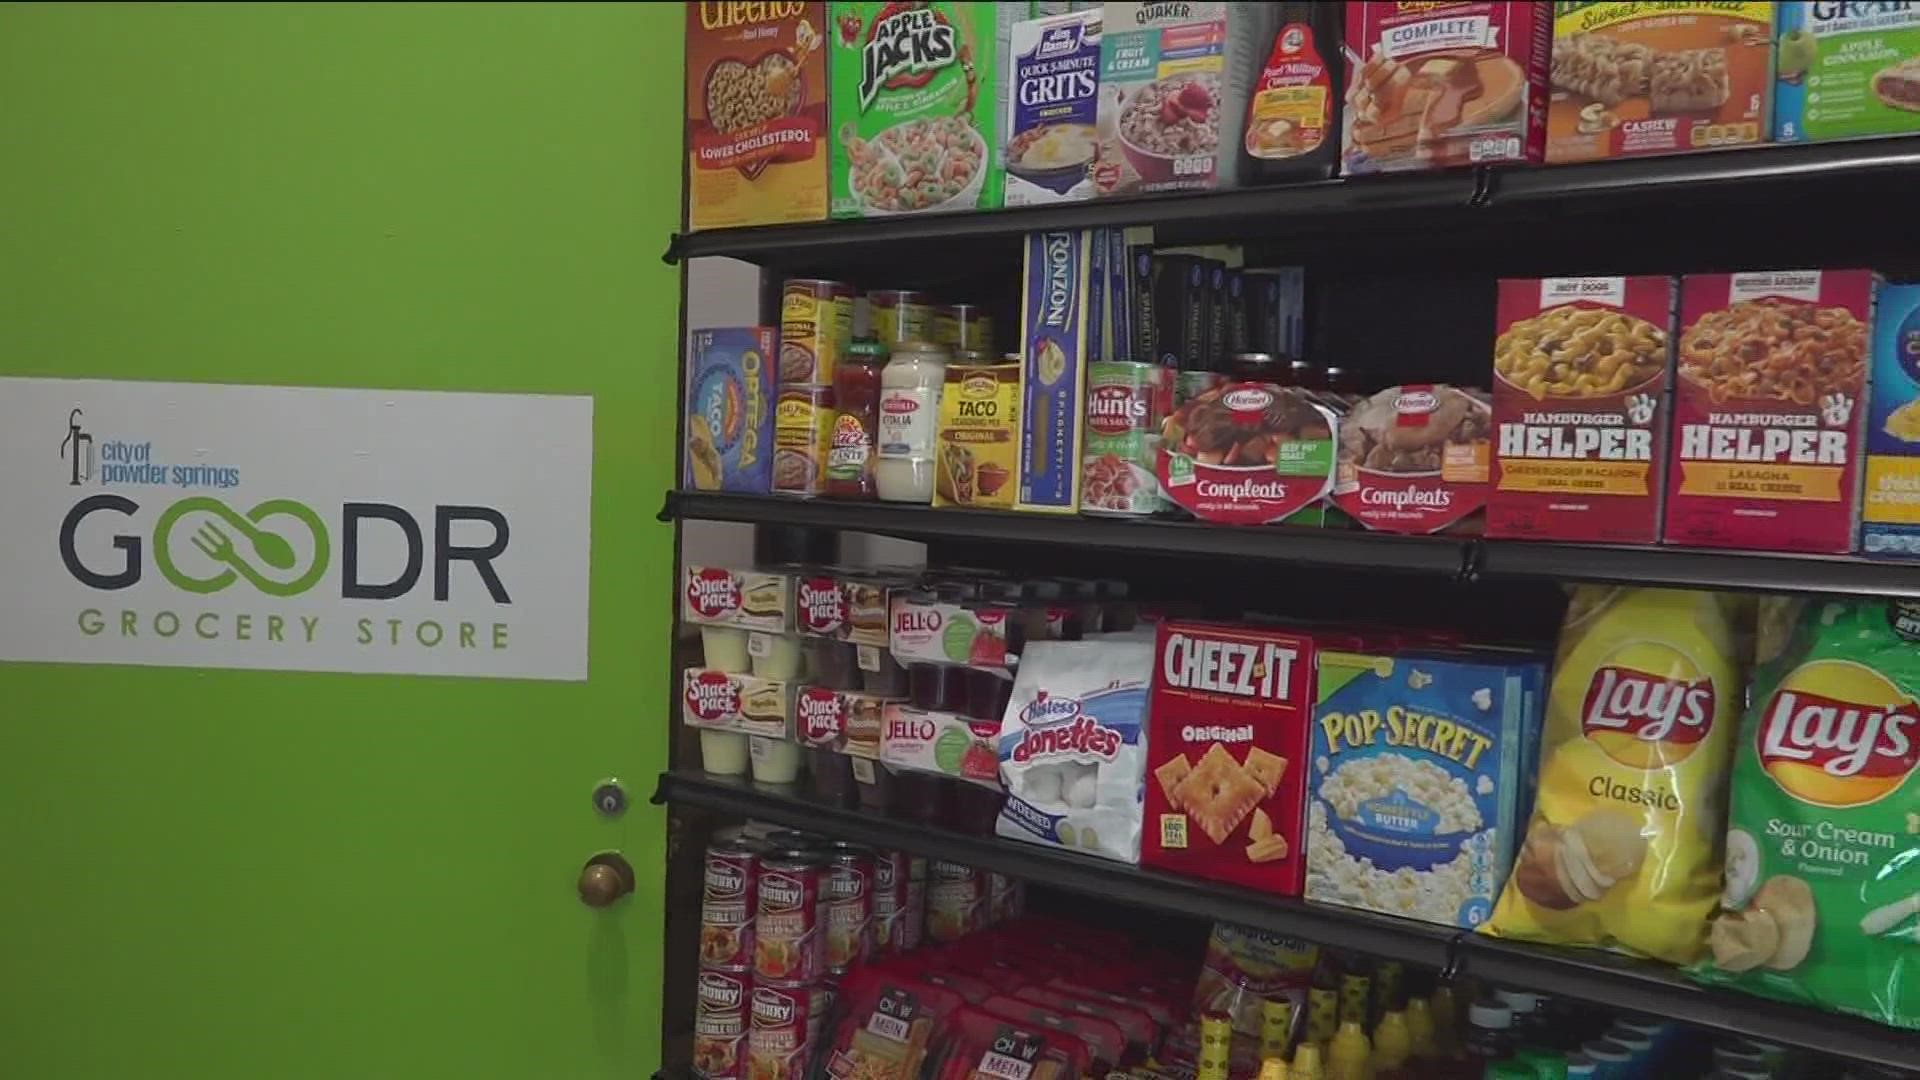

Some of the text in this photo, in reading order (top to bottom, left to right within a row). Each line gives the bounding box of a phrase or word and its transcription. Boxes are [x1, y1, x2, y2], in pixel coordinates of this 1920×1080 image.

[1136, 3, 1190, 25] QUAKER
[1580, 3, 1640, 31] Sweet
[877, 12, 933, 42] APPLE
[1391, 19, 1476, 43] COMPLETE
[861, 27, 955, 103] JACKS
[1020, 63, 1048, 79] QUICK
[1020, 69, 1096, 106] GRITS
[1622, 118, 1678, 133] CASHEW
[700, 146, 735, 159] LOWER
[735, 129, 811, 154] CHOLESTEROL
[1047, 232, 1071, 327] RONZONI
[1580, 281, 1610, 292] DOGS
[710, 381, 723, 437] TACO
[958, 400, 998, 417] TACO
[1088, 391, 1147, 417] Hunt's
[1523, 412, 1624, 425] HAMBURGER
[1709, 412, 1818, 426] HAMBURGER
[1497, 423, 1652, 461] HELPER
[1680, 424, 1848, 464] HELPER
[101, 463, 240, 489] powder springs
[1728, 469, 1790, 481] LASAGNA
[1197, 478, 1286, 503] Compleats
[1360, 484, 1450, 511] Compleats
[690, 575, 737, 595] Snack
[800, 584, 843, 607] Snack
[700, 591, 737, 613] pack
[809, 603, 842, 623] pack
[78, 608, 510, 650] GROCERY STORE
[688, 679, 737, 700] Snack
[699, 695, 736, 717] pack
[800, 694, 841, 717] Snack
[1586, 668, 1712, 742] Lay's
[807, 713, 840, 734] pack
[1763, 693, 1917, 777] Lay's
[1013, 717, 1121, 762] donettes
[1588, 775, 1682, 812] Classic
[1375, 813, 1419, 829] BUTTER
[1765, 818, 1896, 848] Sour Cream
[1780, 839, 1870, 866] & Onion
[1468, 905, 1479, 924] 6
[874, 1015, 905, 1035] MEIN
[988, 1057, 1025, 1077] MEIN
